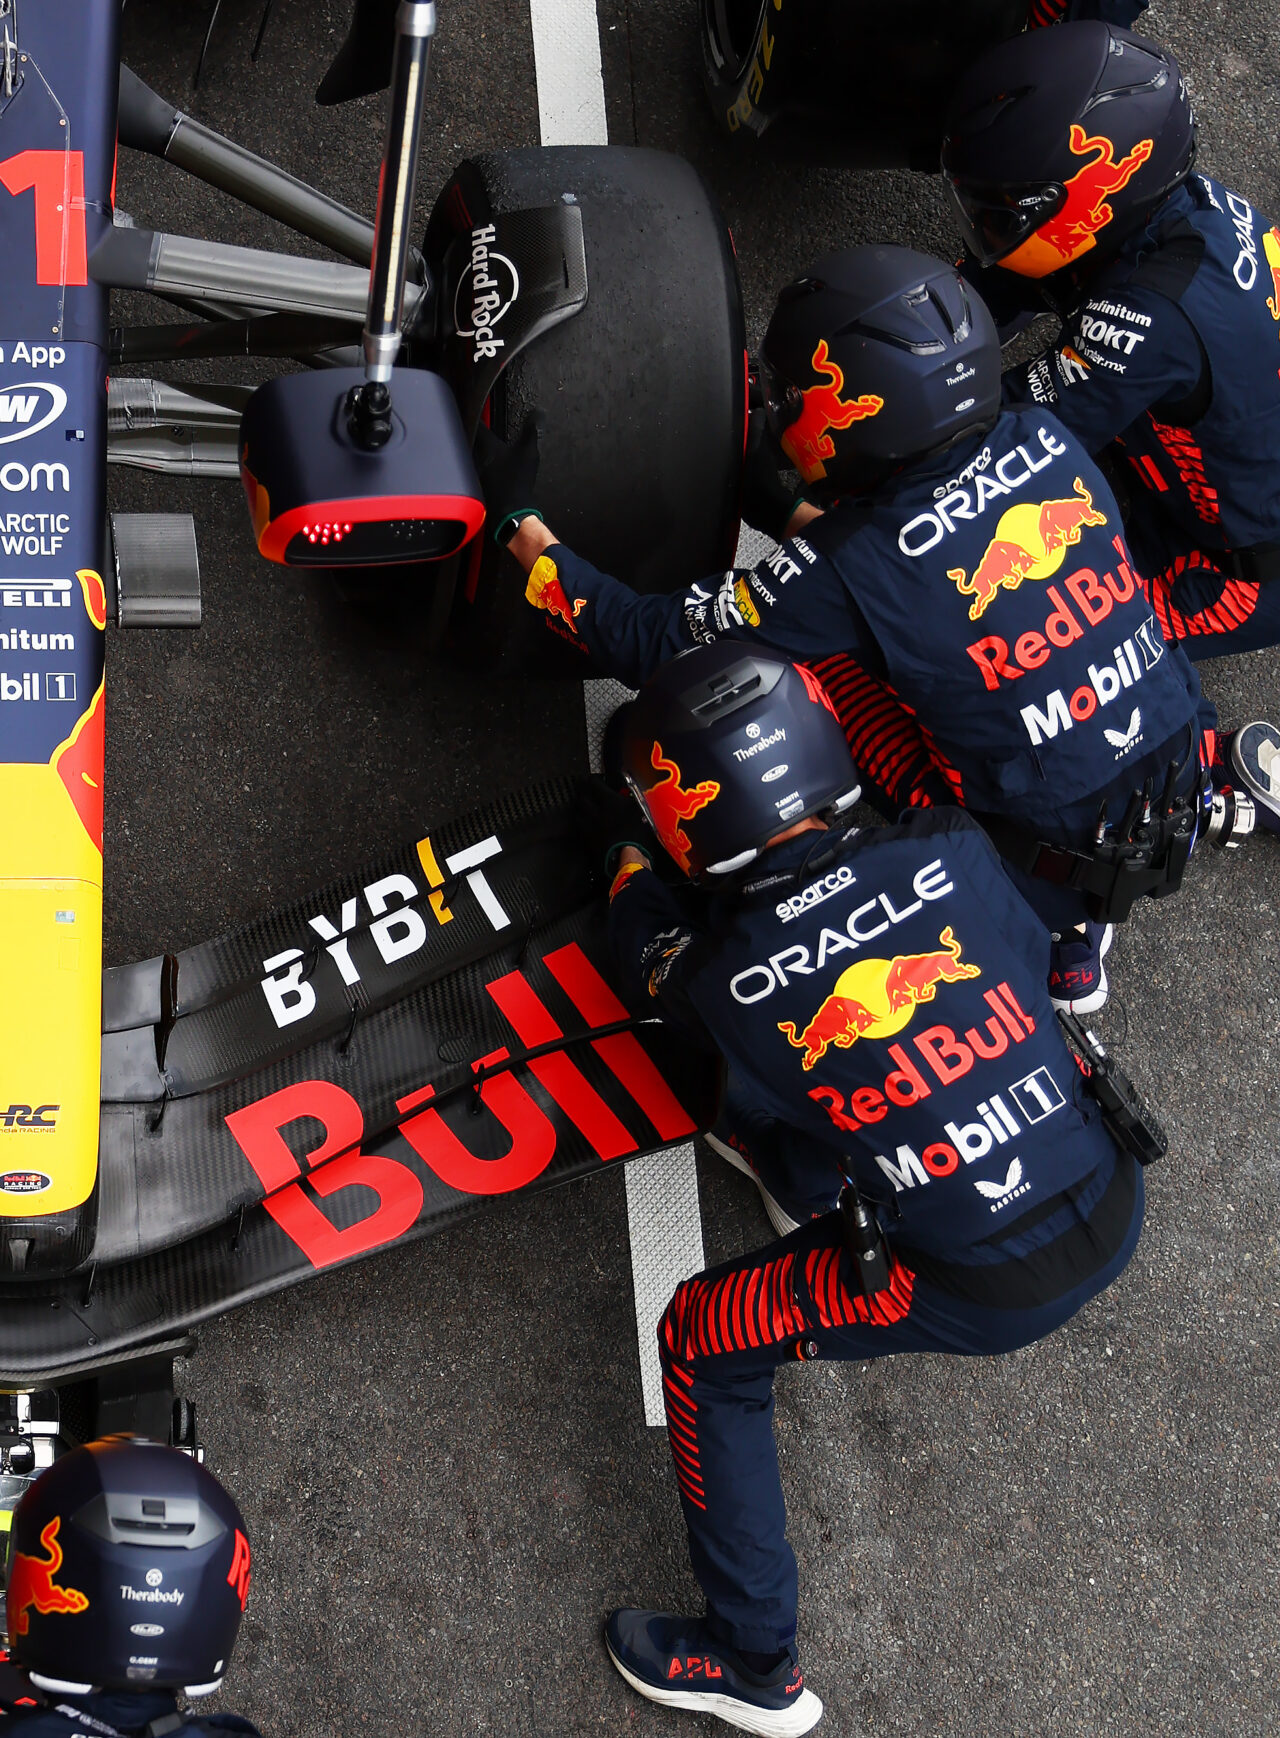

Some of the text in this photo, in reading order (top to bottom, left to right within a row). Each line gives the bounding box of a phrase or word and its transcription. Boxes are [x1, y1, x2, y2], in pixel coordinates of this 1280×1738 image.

[471, 223, 505, 363] Hard Rock
[11, 342, 66, 369] App
[1080, 314, 1145, 355] ROKT
[1027, 369, 1048, 403] WOLF
[1037, 359, 1058, 403] ARCTIC
[898, 427, 1067, 557] ORACLE
[933, 446, 991, 498] sparco
[1, 536, 63, 556] WOLF
[966, 585, 1084, 691] Red
[1019, 639, 1142, 746] Mobil
[732, 728, 787, 762] Therabody
[775, 866, 857, 924] sparco
[729, 858, 954, 1004] ORACLE
[808, 982, 1037, 1133] Red Bull
[224, 941, 699, 1270] Bull
[874, 1094, 1021, 1193] Mobil
[989, 1181, 1032, 1213] CASTORE
[120, 1584, 184, 1607] Therabody
